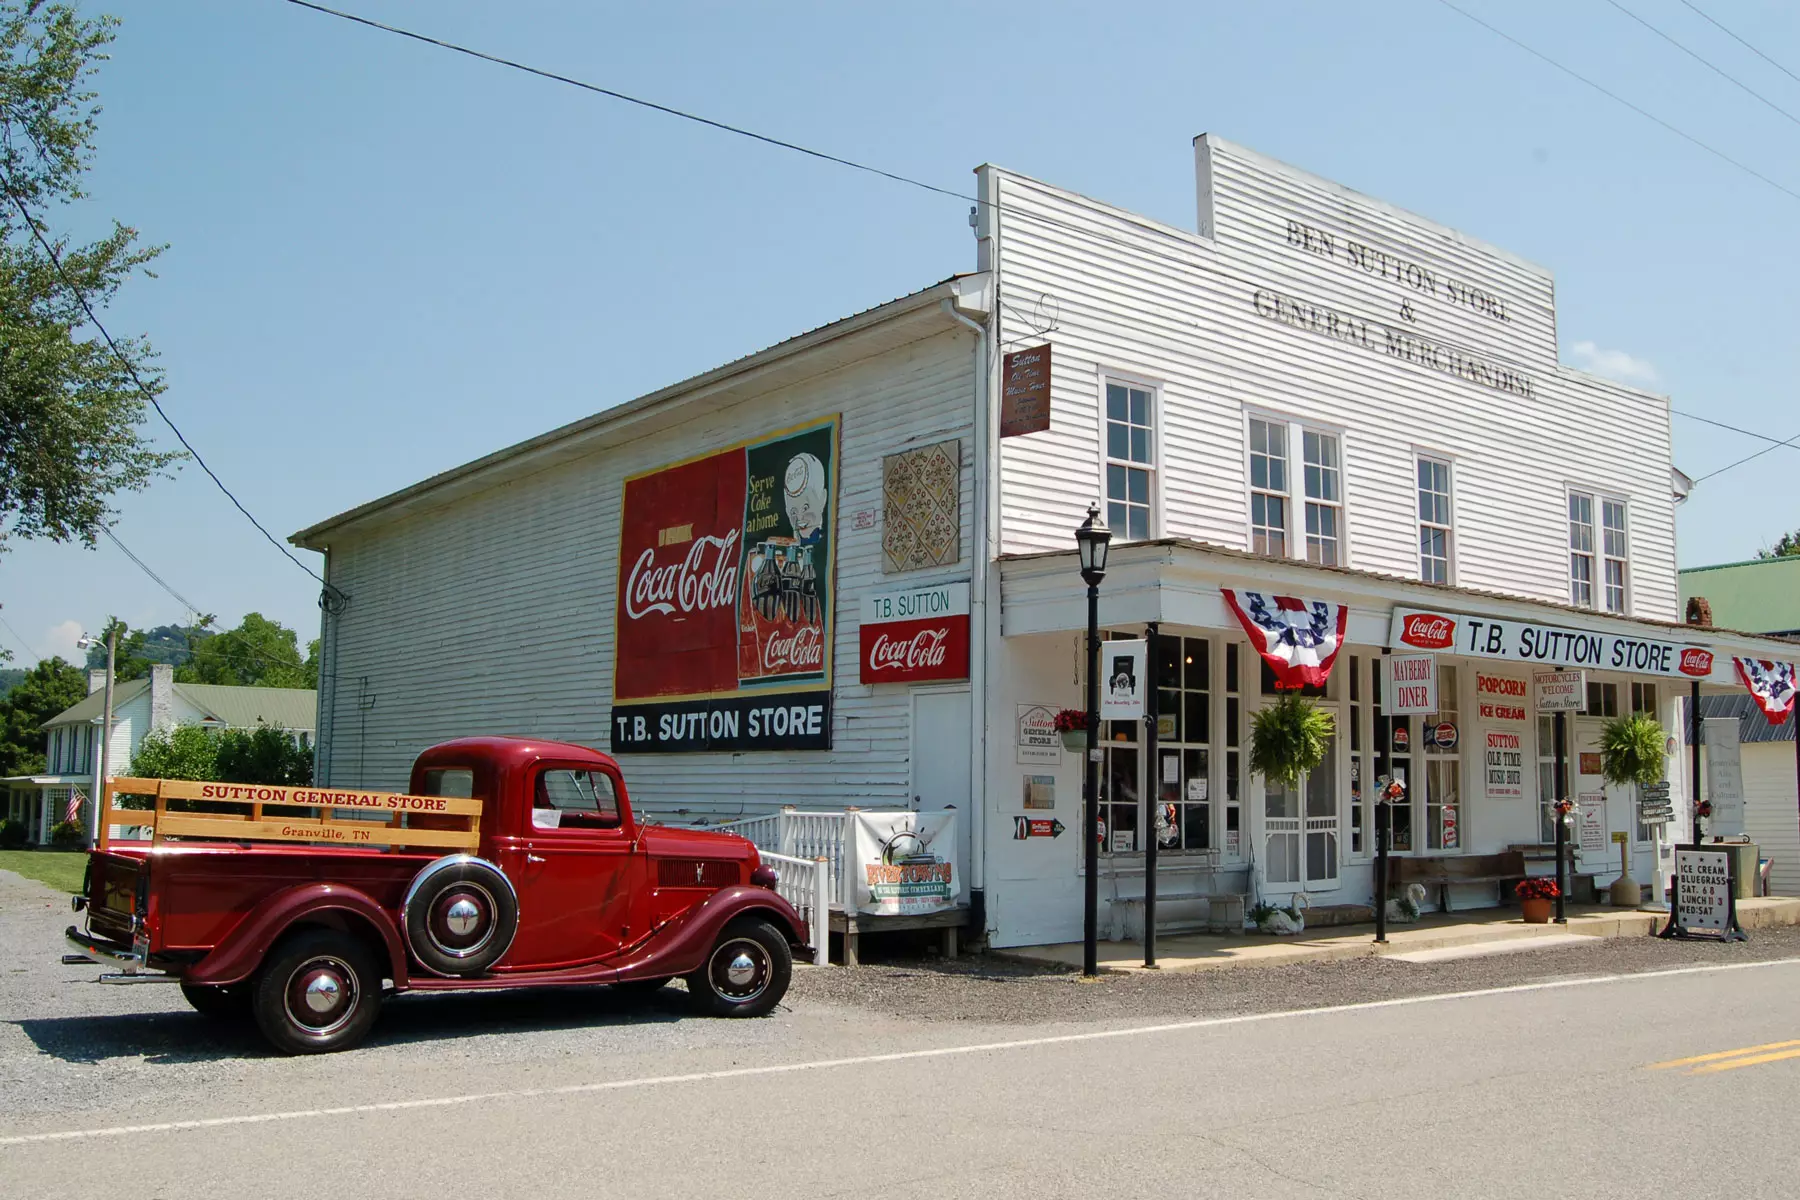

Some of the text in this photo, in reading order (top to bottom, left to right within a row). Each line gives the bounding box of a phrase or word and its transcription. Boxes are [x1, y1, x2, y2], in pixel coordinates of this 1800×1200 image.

[1287, 219, 1512, 323] BEN SUTTON STORE
[1400, 297, 1416, 324] &
[1253, 289, 1538, 401] GENERAL MERCHANDISE
[749, 474, 775, 494] Serve
[750, 493, 772, 512] Coke
[625, 527, 741, 619] Coca-Cola
[873, 590, 949, 620] T.B. SUTTON
[765, 626, 822, 668] Coca-Cola
[869, 628, 949, 671] Coca-Cola
[1468, 621, 1673, 673] T.B. SUTTON STORE
[1393, 659, 1432, 681] MAYBERRY
[1534, 673, 1580, 684] MOTORCYCLES
[1398, 686, 1429, 708] DINER
[1478, 675, 1527, 697] POPCORN
[1541, 685, 1574, 695] WELCOME
[1480, 703, 1526, 720] ICE CREAM
[617, 705, 823, 742] T.B. SUTTON STORE
[1487, 733, 1519, 749] SUTTON
[1487, 751, 1521, 767] OLE TIME
[1488, 769, 1505, 784] MUSIC
[202, 785, 447, 811] SUTTON GENERAL STORE
[282, 826, 370, 841] Granville, TN
[866, 862, 952, 886] RIVERTOWNS
[1681, 865, 1725, 875] ICE CREAM
[1681, 875, 1726, 885] BLUEGRASS
[1681, 885, 1699, 894] SAT.
[1682, 895, 1707, 905] LUNCH
